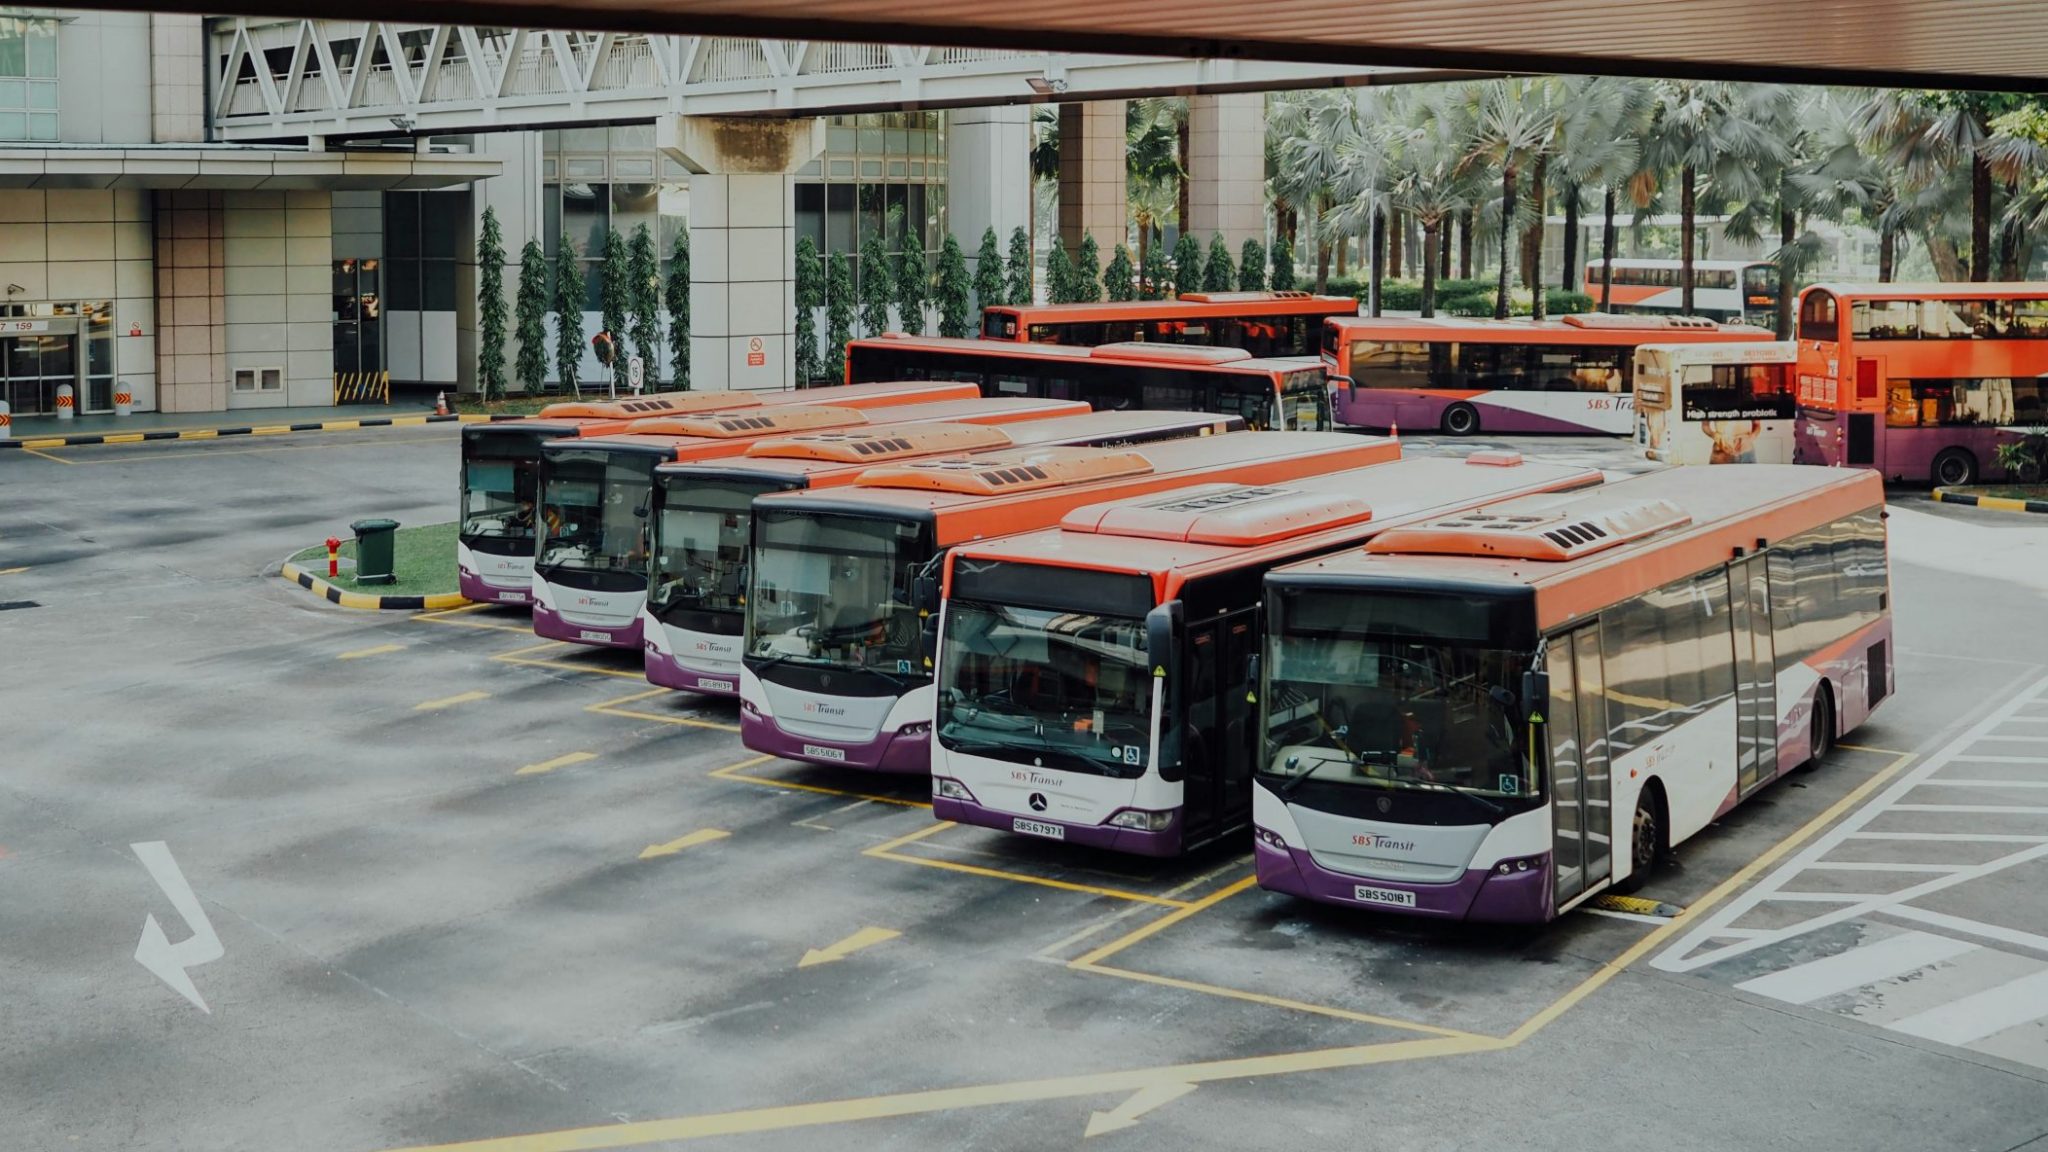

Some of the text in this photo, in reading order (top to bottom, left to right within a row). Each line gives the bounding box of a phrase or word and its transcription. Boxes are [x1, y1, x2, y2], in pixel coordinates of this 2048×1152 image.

[16, 322, 32, 330] 159
[632, 366, 639, 378] 15
[1587, 399, 1610, 409] SBS
[1708, 409, 1740, 418] strength
[1742, 408, 1777, 418] probiotic
[696, 642, 732, 652] SBS Transit
[803, 703, 845, 716] SBS Transit
[1011, 771, 1063, 787] SBS Transit
[1352, 835, 1415, 851] SBS Transit
